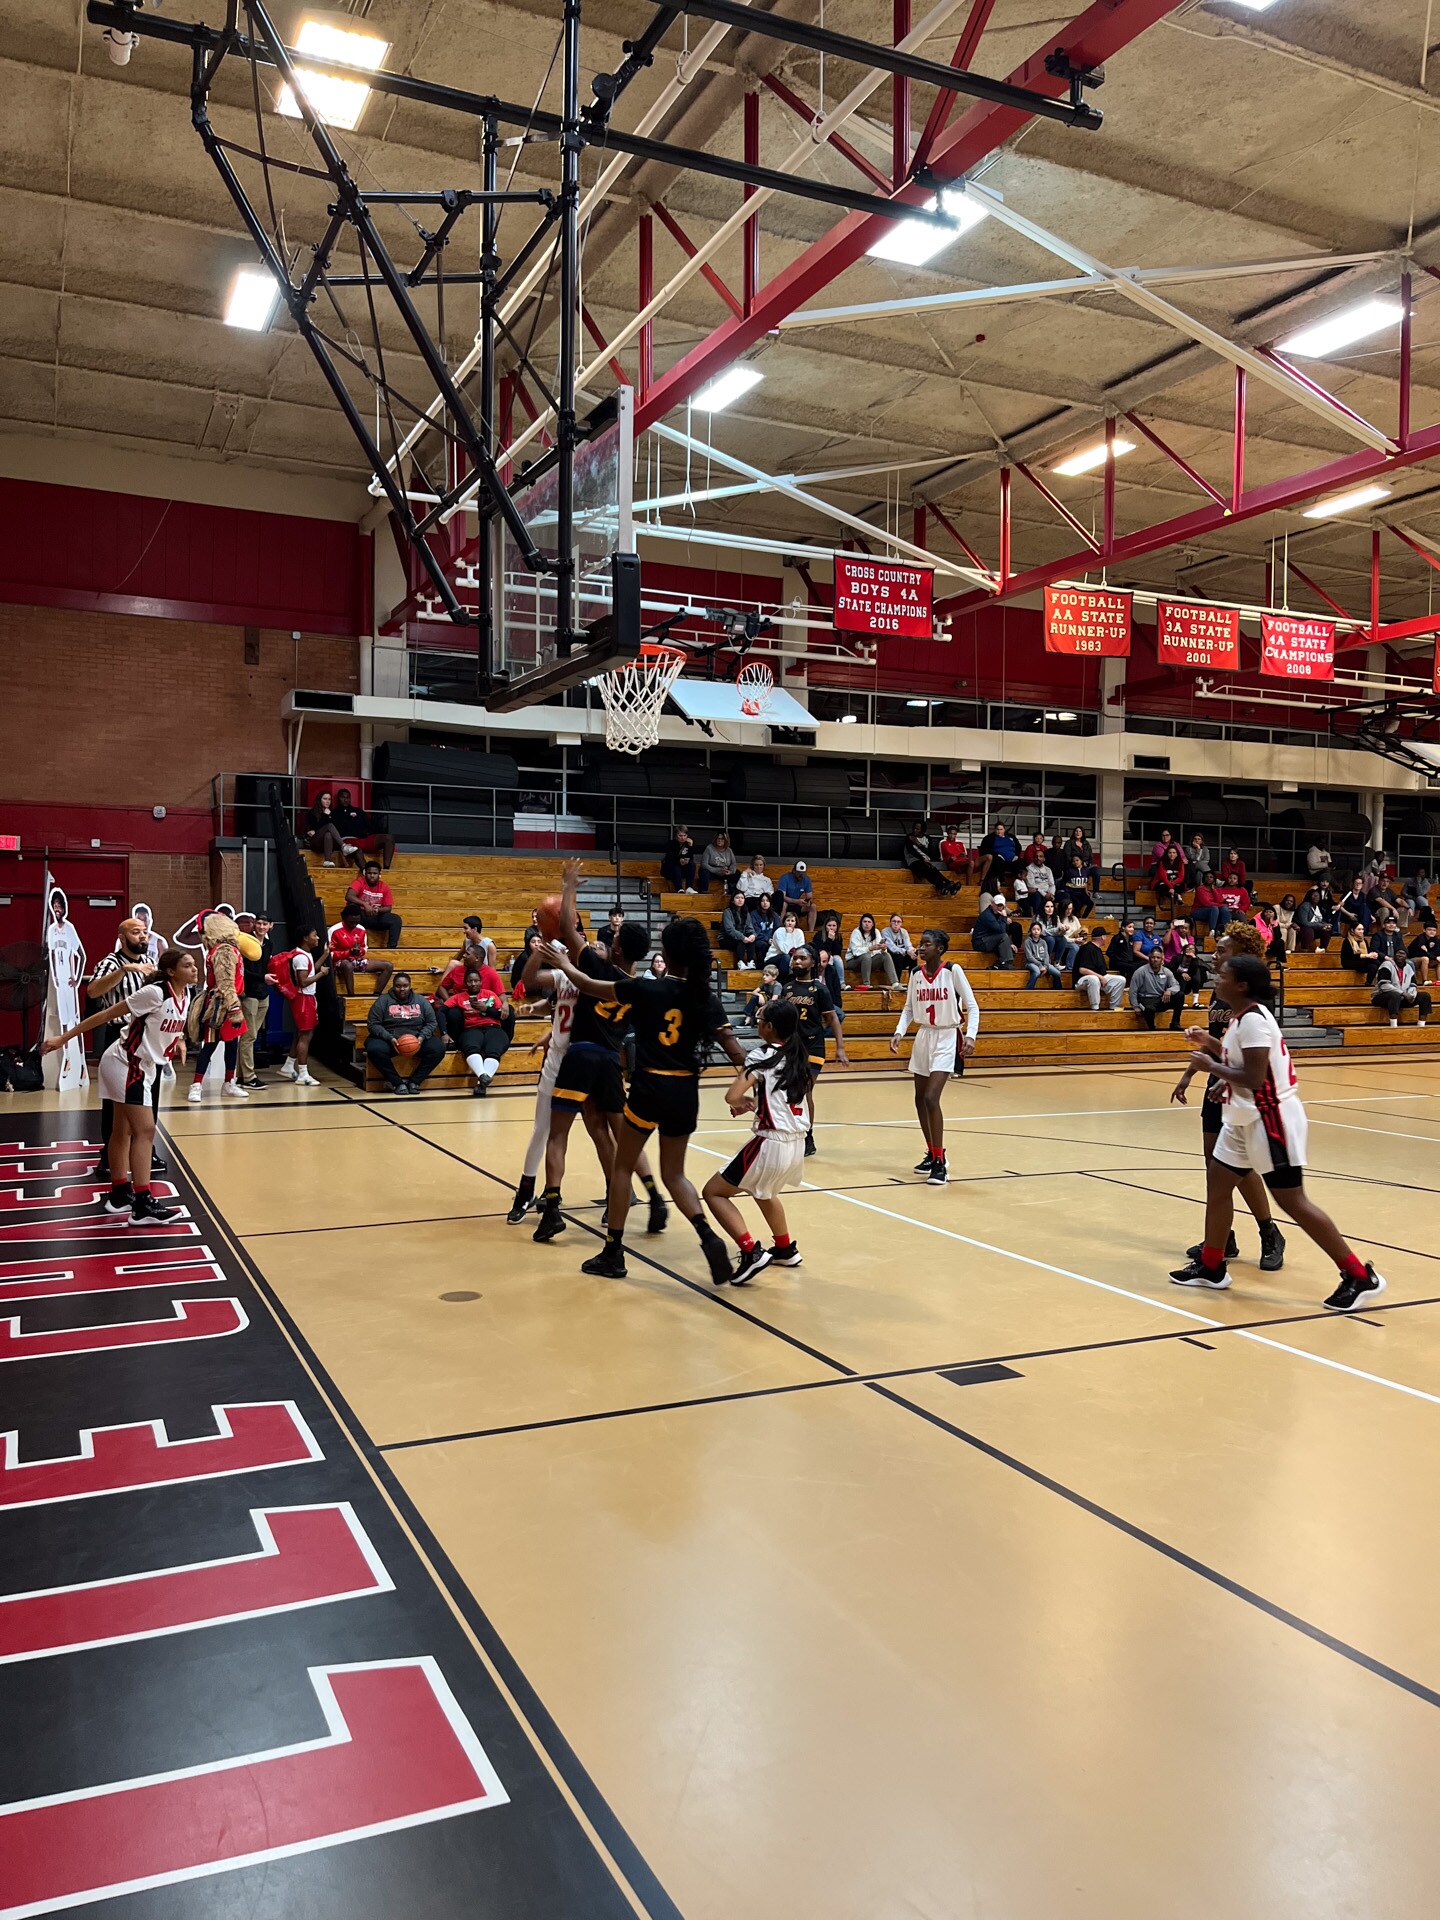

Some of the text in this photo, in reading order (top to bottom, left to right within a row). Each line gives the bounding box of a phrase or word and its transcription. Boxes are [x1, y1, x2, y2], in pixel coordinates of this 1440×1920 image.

[845, 565, 922, 585] CROSS COUNTRY
[851, 582, 918, 601] BOYS 4A
[838, 596, 927, 618] STATE CHAMPIONS
[1051, 593, 1125, 609] FOOTBALL
[869, 616, 899, 630] 2016
[1052, 608, 1124, 624] AA STATE
[1165, 606, 1232, 624] FOOTBALL
[1050, 622, 1127, 638] RUNNER-UP
[1166, 621, 1231, 638] 3A STATE
[1267, 620, 1330, 637] FOOTBALL
[1075, 640, 1102, 652] 1983
[1163, 634, 1234, 652] RUNNER-UP
[1269, 634, 1327, 650] 4A STATE
[1186, 651, 1211, 664] 2001
[1265, 646, 1334, 663] CHAMPIONS
[925, 1004, 937, 1026] 1
[658, 1008, 684, 1046] 3
